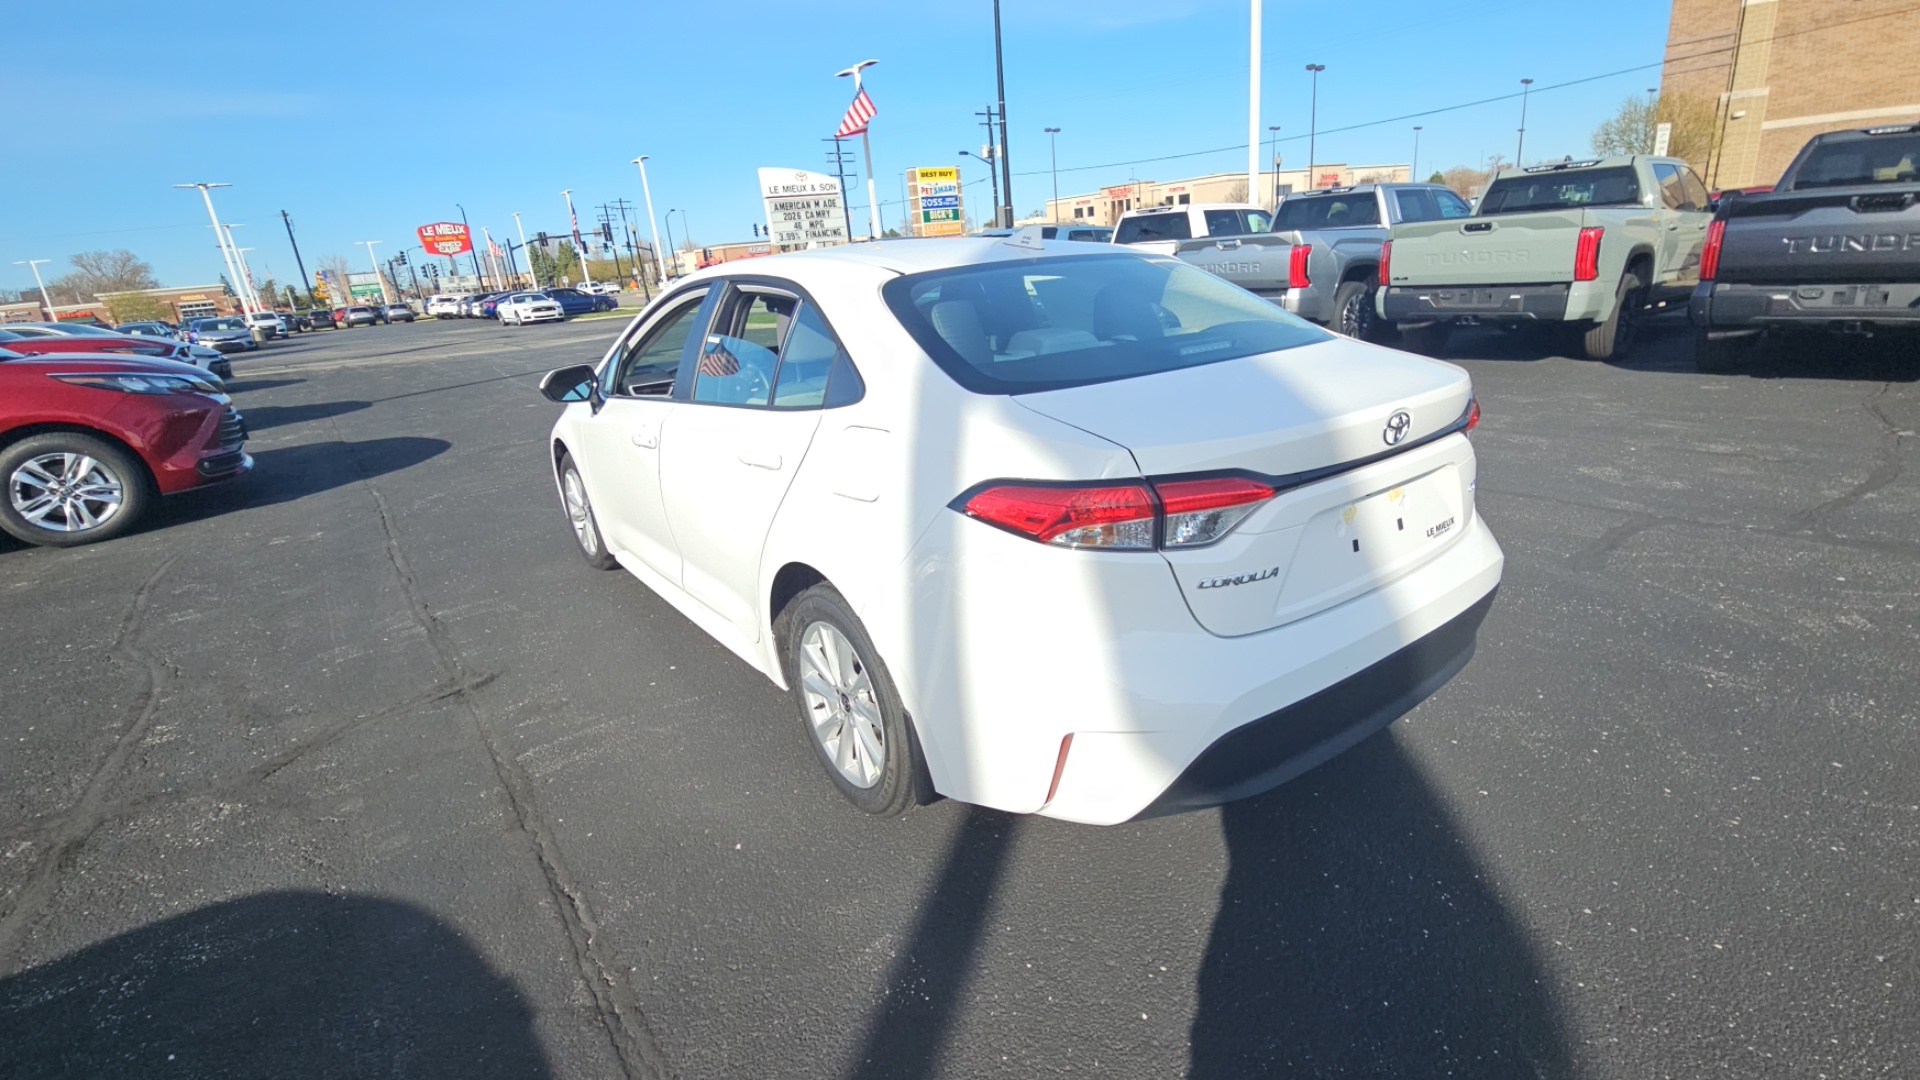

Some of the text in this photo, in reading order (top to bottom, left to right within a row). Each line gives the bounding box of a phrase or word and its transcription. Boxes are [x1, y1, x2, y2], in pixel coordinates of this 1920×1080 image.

[769, 182, 837, 195] LE MIEUX & SON
[774, 201, 811, 212] AMERICAN
[922, 198, 943, 208] ROSS
[783, 210, 830, 223] 2026 CAMRY
[422, 224, 465, 236] LE MIEUX
[794, 220, 824, 230] 46 MPG
[805, 229, 842, 240] FINANCING
[1425, 248, 1531, 266] TUNDRA
[1426, 527, 1436, 538] LE
[1436, 516, 1455, 533] MIEUX
[1197, 566, 1279, 589] COROLLA
